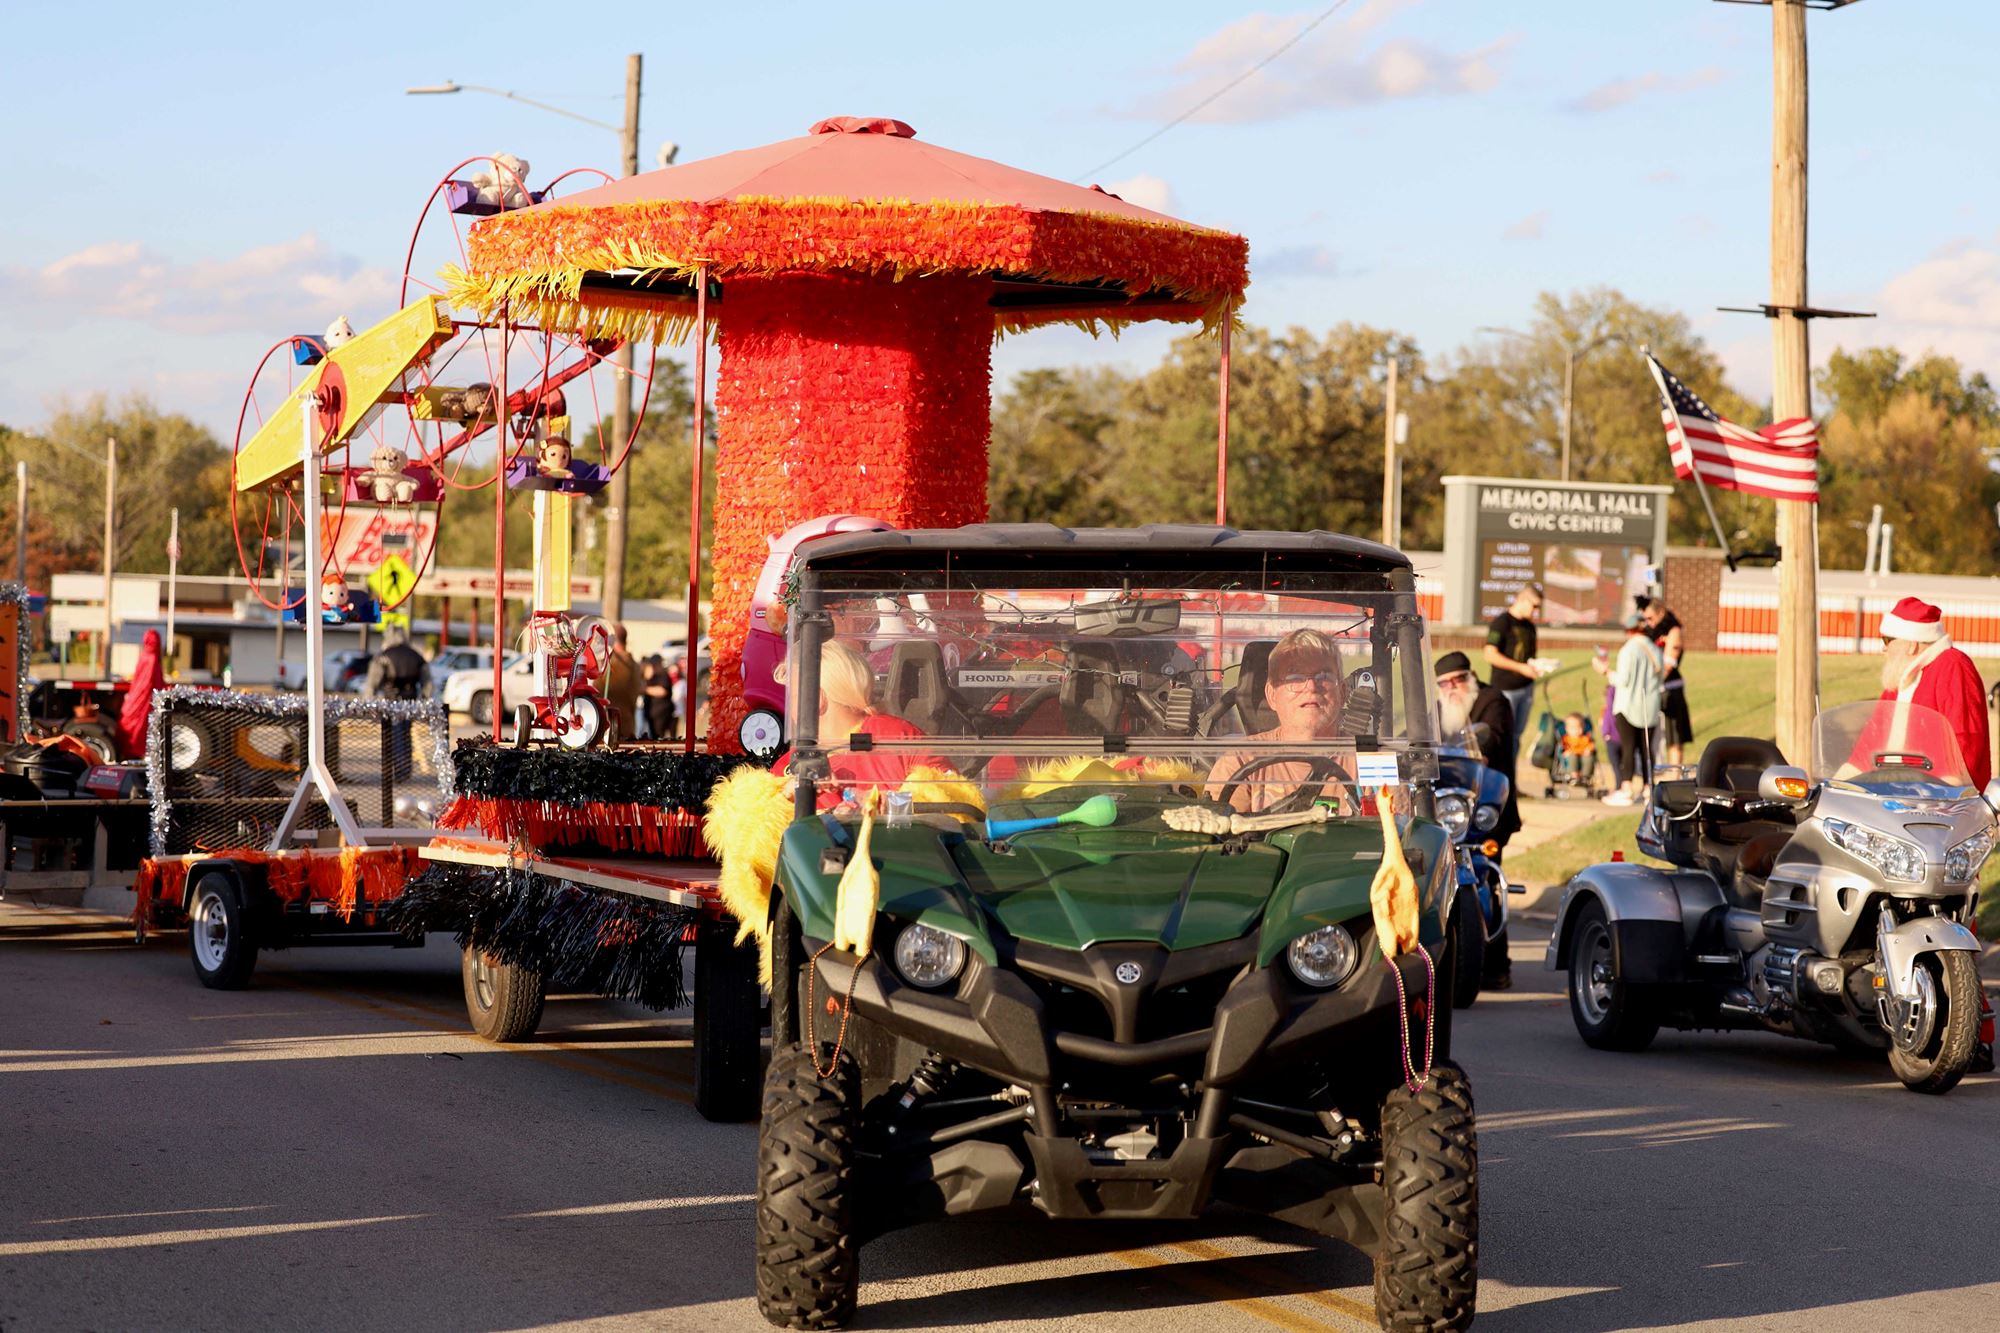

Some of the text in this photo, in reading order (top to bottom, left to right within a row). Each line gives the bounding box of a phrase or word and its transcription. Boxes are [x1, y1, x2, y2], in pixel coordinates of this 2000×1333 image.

[1481, 487, 1652, 516] MEMORIAL HALL
[1508, 511, 1624, 534] CIVIC CENTER
[964, 674, 1016, 683] HONDA
